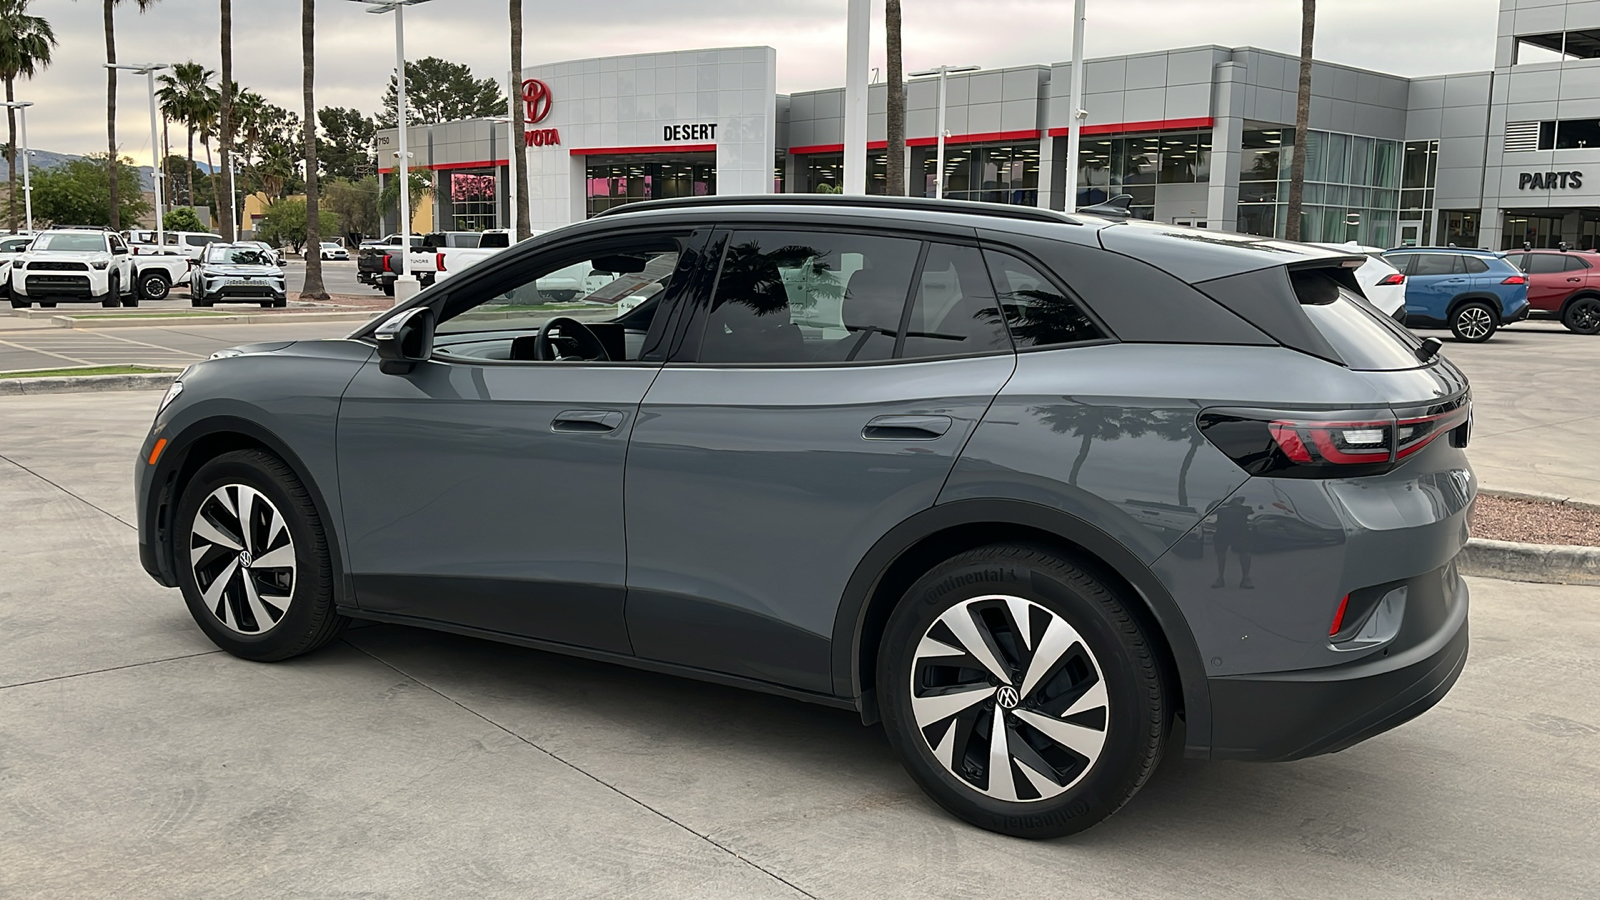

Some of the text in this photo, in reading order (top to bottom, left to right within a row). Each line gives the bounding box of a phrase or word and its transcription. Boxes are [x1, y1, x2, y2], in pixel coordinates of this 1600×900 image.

[524, 128, 560, 147] YOTA
[663, 123, 718, 141] DESERT
[1518, 170, 1583, 190] PARTS
[923, 567, 1004, 606] Continental
